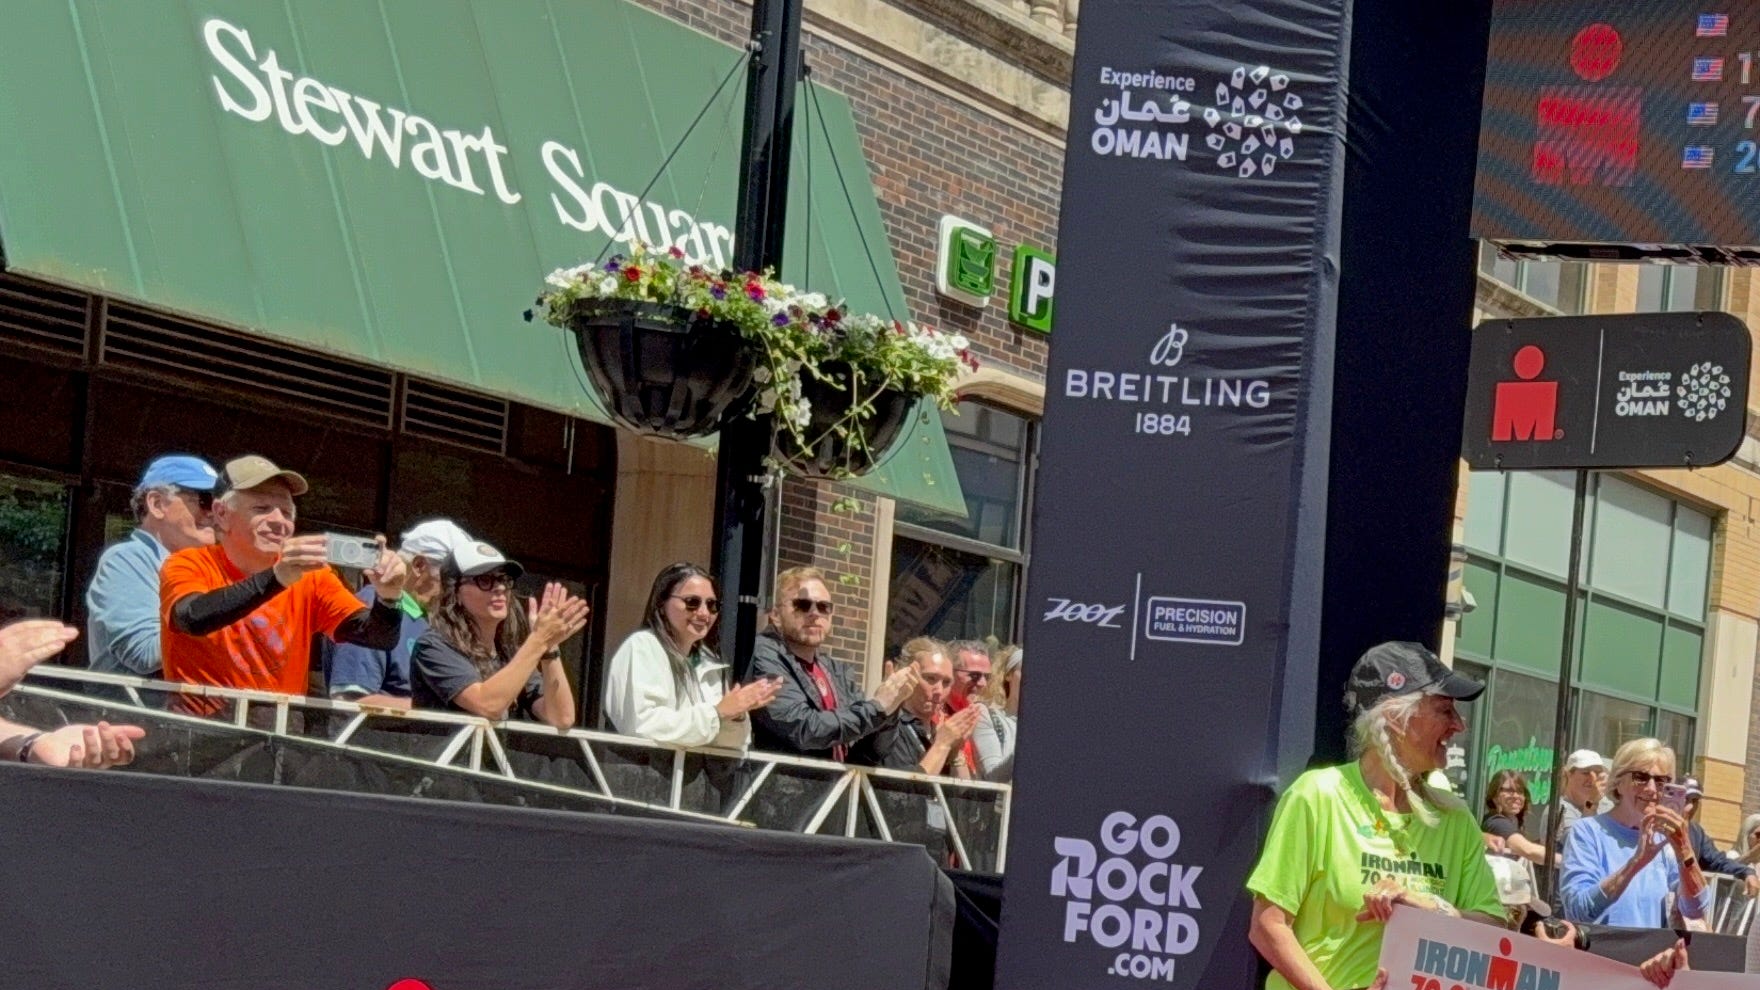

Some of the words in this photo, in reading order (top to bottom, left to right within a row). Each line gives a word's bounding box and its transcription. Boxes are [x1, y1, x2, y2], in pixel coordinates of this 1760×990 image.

[1101, 67, 1195, 91] Experience
[202, 19, 521, 204] Stewart
[1091, 128, 1189, 161] OMAN
[1066, 369, 1270, 409] BREITLING
[1619, 371, 1672, 382] Experience
[1615, 400, 1669, 416] OMAN
[1135, 412, 1192, 436] 1884
[1154, 606, 1238, 625] PRECISION
[1154, 622, 1176, 632] FUEL
[1185, 625, 1236, 636] HYDRATION
[1101, 811, 1180, 860] GO
[1050, 836, 1203, 910] ROCK
[1361, 851, 1445, 880] IRONMAN
[1063, 901, 1199, 955] FORD
[1107, 953, 1175, 982] .COM
